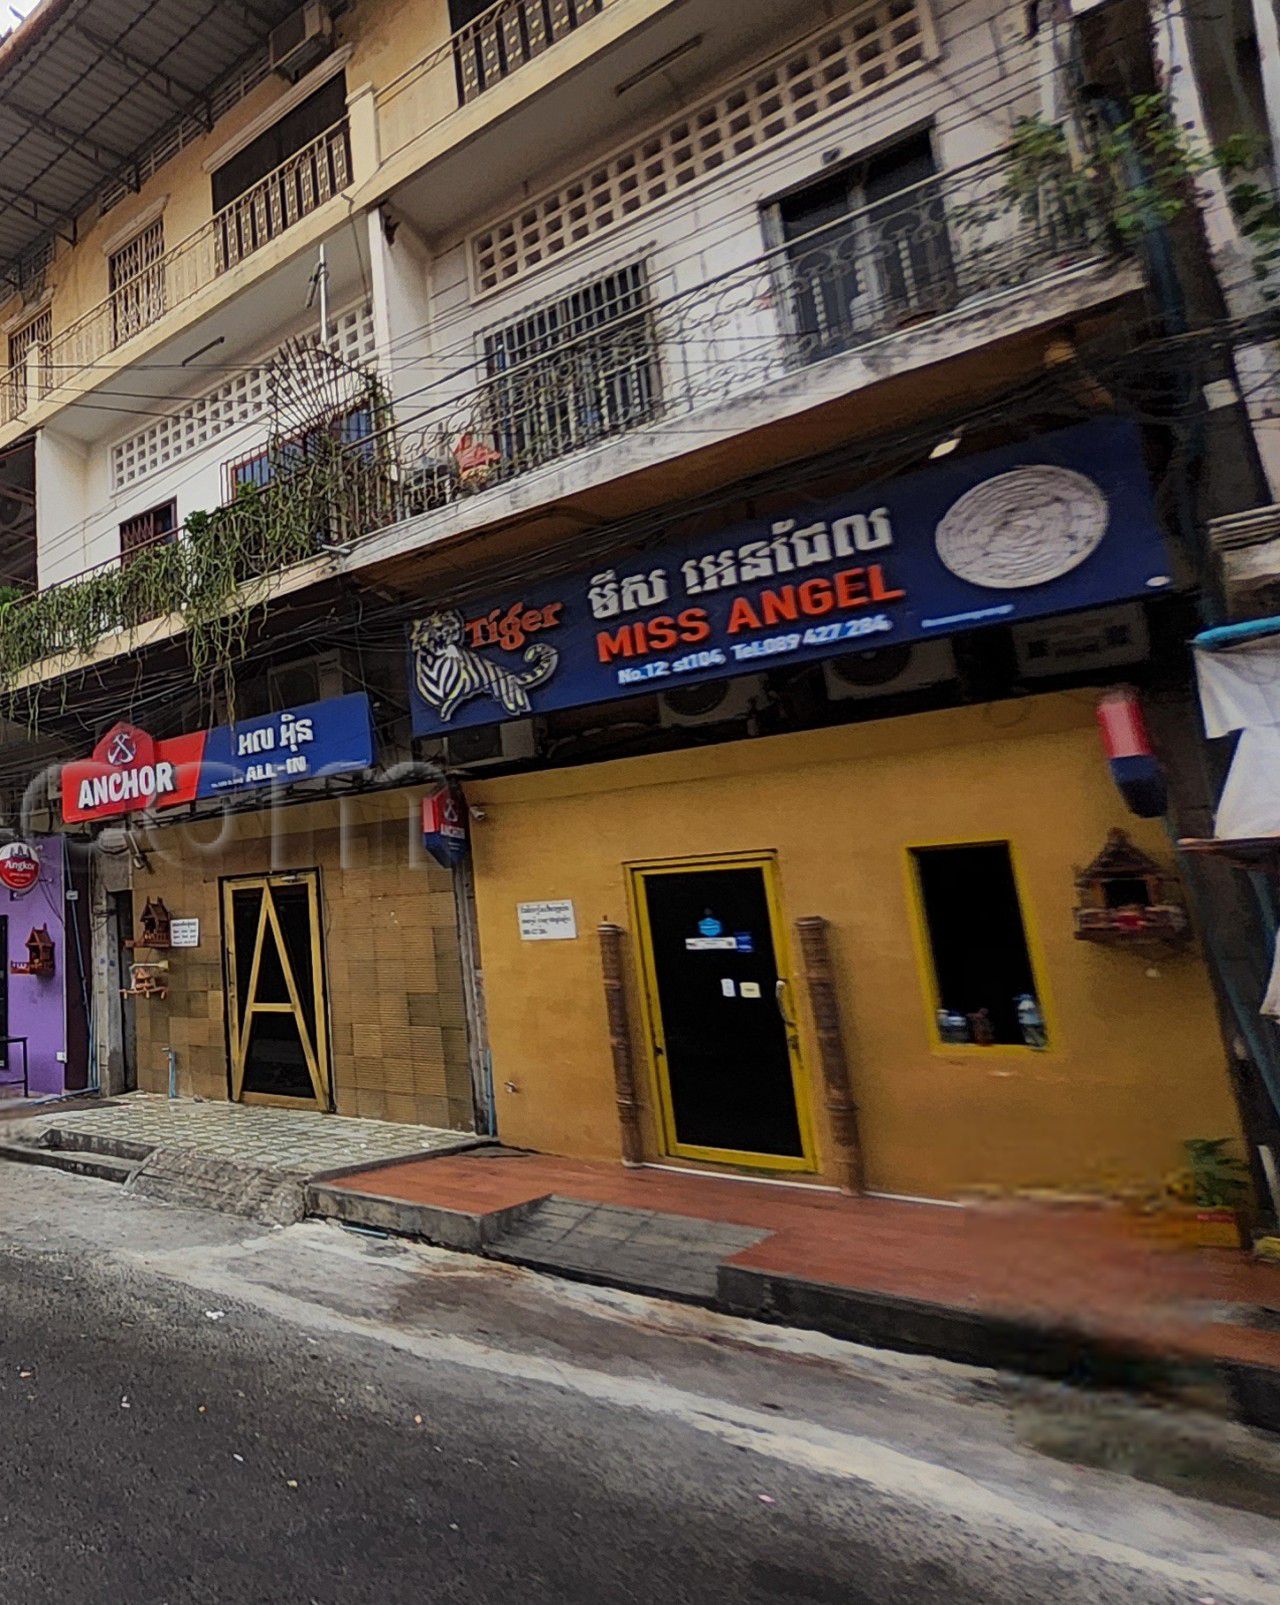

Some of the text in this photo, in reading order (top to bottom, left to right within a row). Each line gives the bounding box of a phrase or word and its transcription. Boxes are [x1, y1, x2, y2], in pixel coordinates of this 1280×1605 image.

[465, 602, 562, 650] Tiger
[596, 564, 907, 663] MISS ANGEL
[78, 762, 175, 809] ANCHOR
[246, 756, 307, 783] ALL-IN
[5, 861, 35, 872] Angkor
